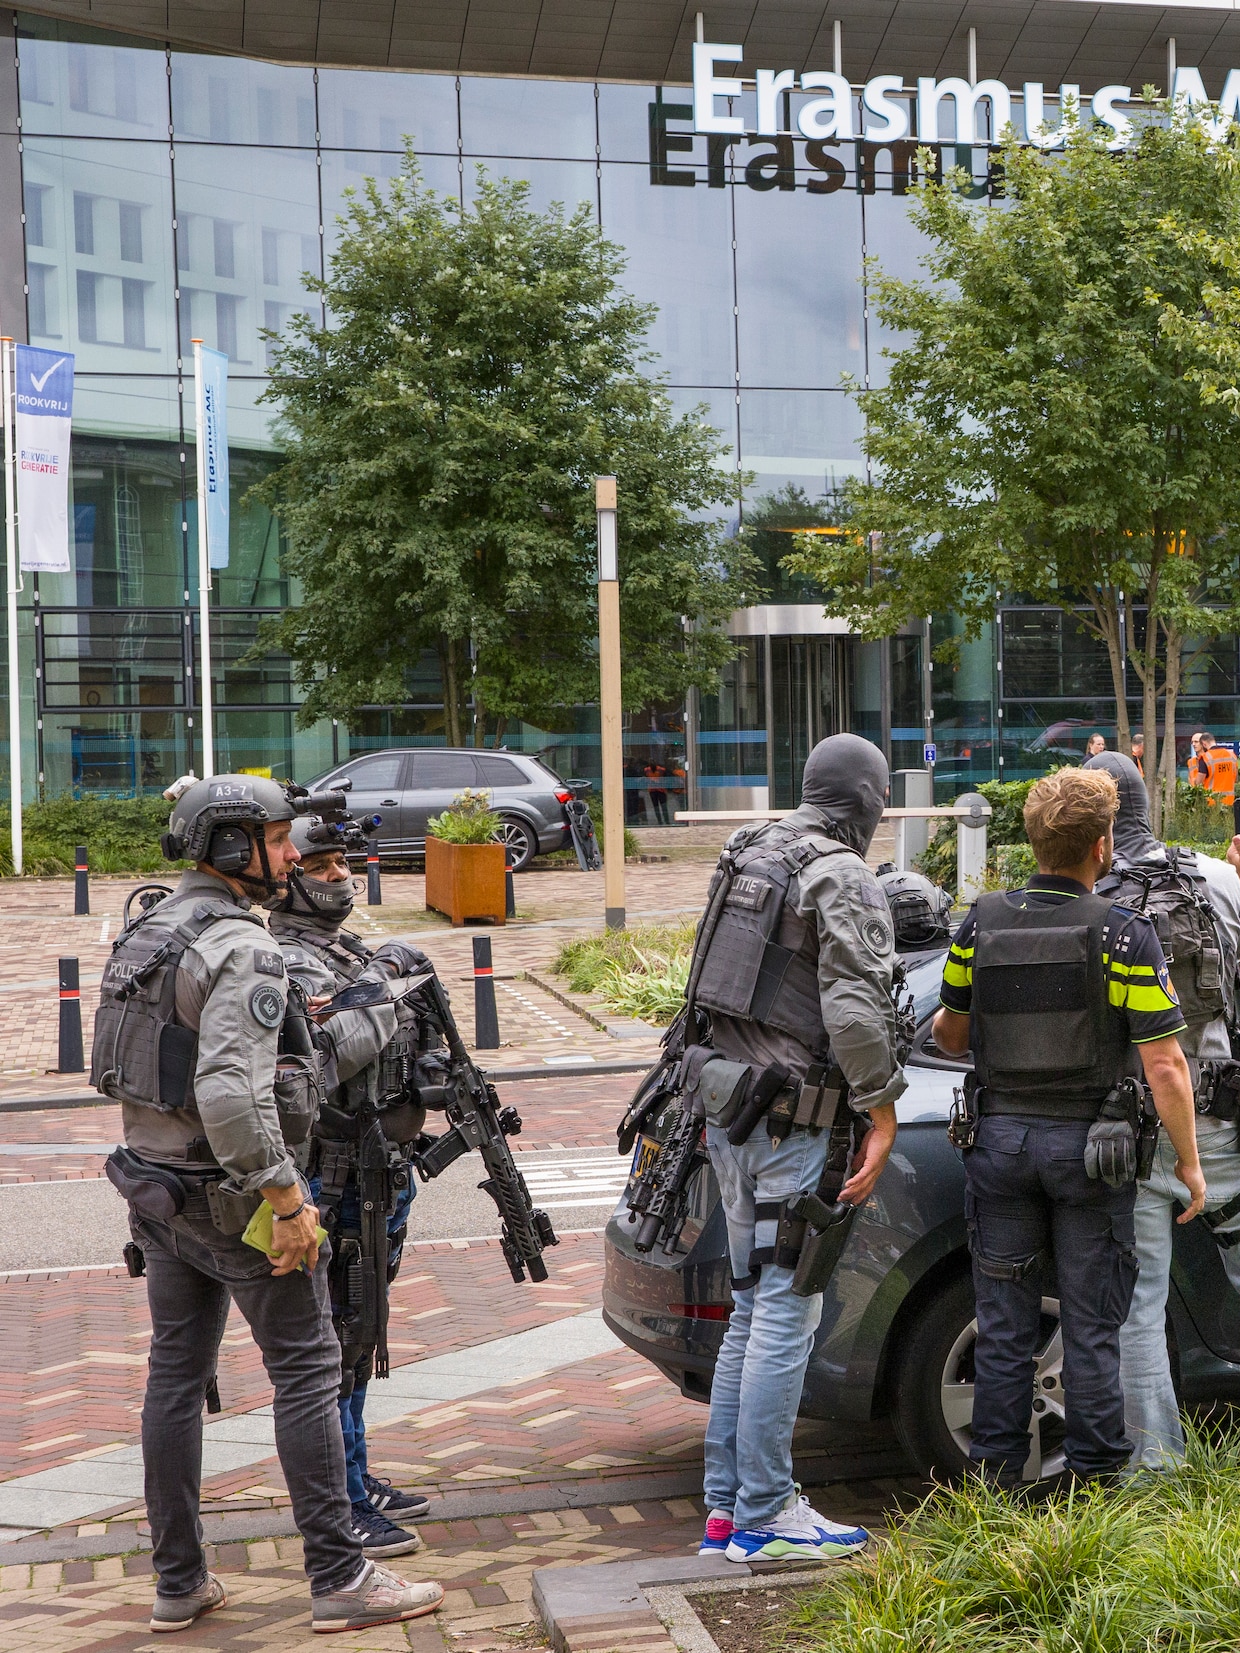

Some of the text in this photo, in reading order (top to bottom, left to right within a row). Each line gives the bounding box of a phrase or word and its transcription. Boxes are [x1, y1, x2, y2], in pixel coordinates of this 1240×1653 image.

[693, 42, 1132, 151] Erasmus
[17, 394, 68, 411] ROOKVRIJ
[205, 415, 217, 493] Erasmus
[21, 460, 59, 475] GENERATIE
[215, 785, 247, 797] A3-7
[731, 877, 759, 893] LITIE
[108, 963, 145, 979] POLIT
